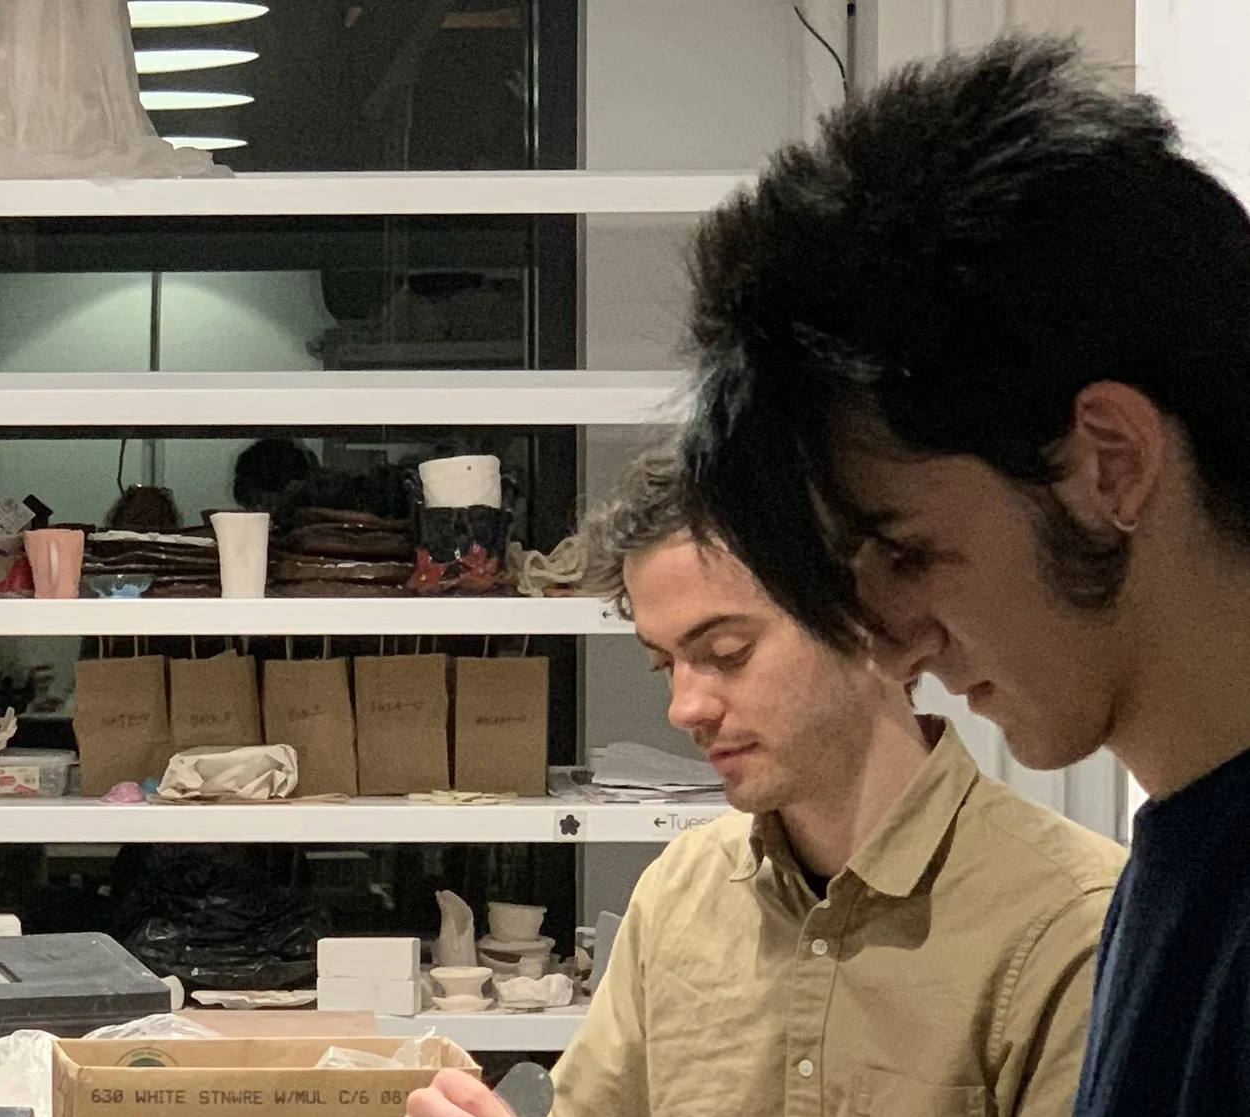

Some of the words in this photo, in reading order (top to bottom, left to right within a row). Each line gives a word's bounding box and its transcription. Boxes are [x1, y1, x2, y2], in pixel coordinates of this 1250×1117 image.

[91, 1088, 124, 1104] 630
[135, 1089, 187, 1104] WHITE
[199, 1090, 263, 1105] STNWRE
[274, 1090, 327, 1105] W/MUL
[339, 1089, 370, 1105] C/6
